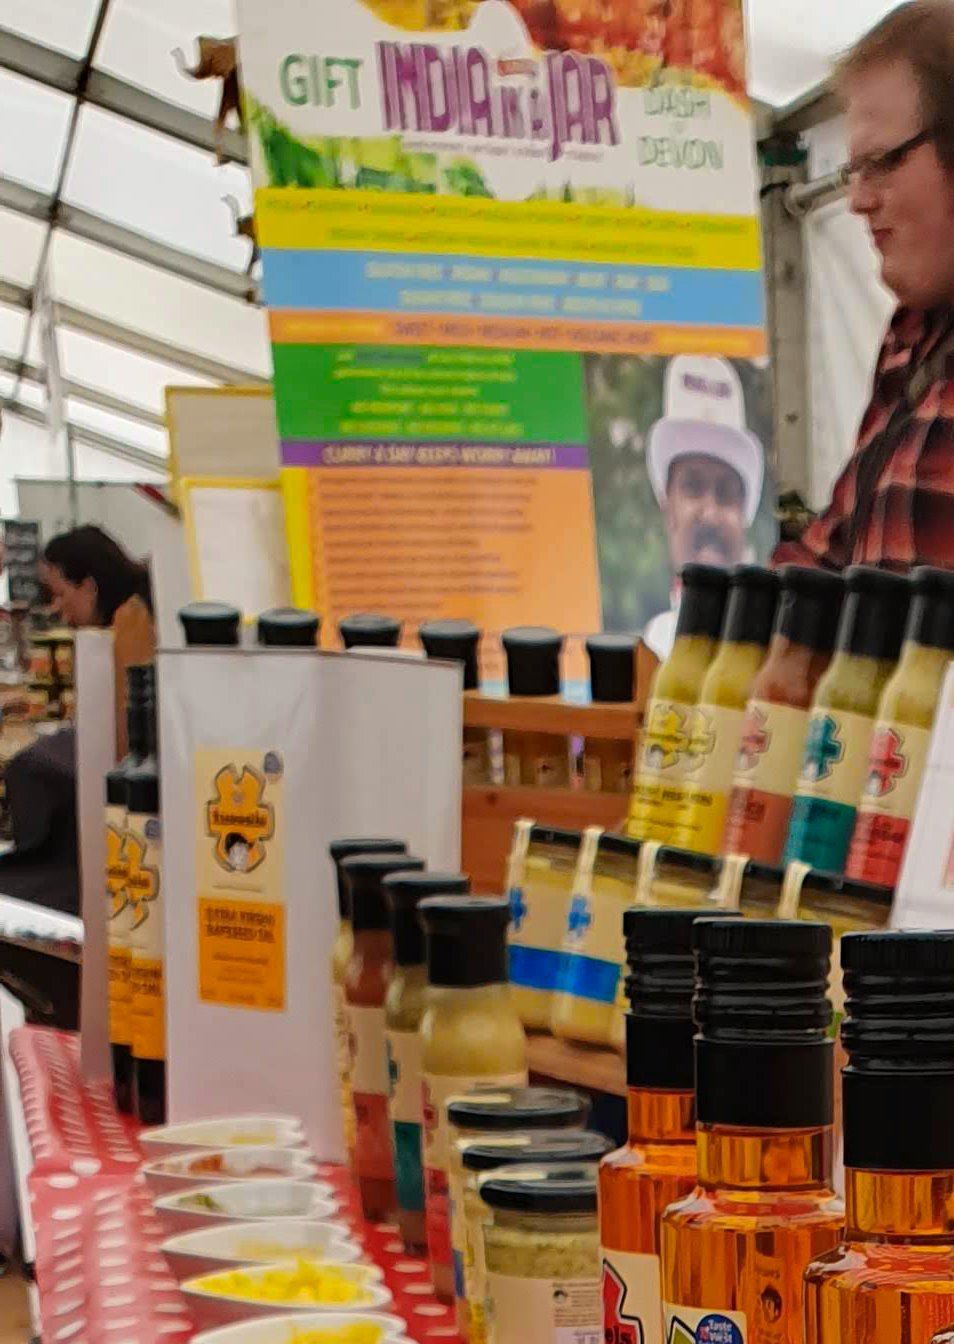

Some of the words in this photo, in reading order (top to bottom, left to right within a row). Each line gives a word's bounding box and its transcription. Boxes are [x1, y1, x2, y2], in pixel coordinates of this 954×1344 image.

[279, 53, 364, 110] GIFT
[376, 40, 494, 136] INDIA
[546, 51, 620, 161] JAR
[638, 136, 726, 171] DEVON
